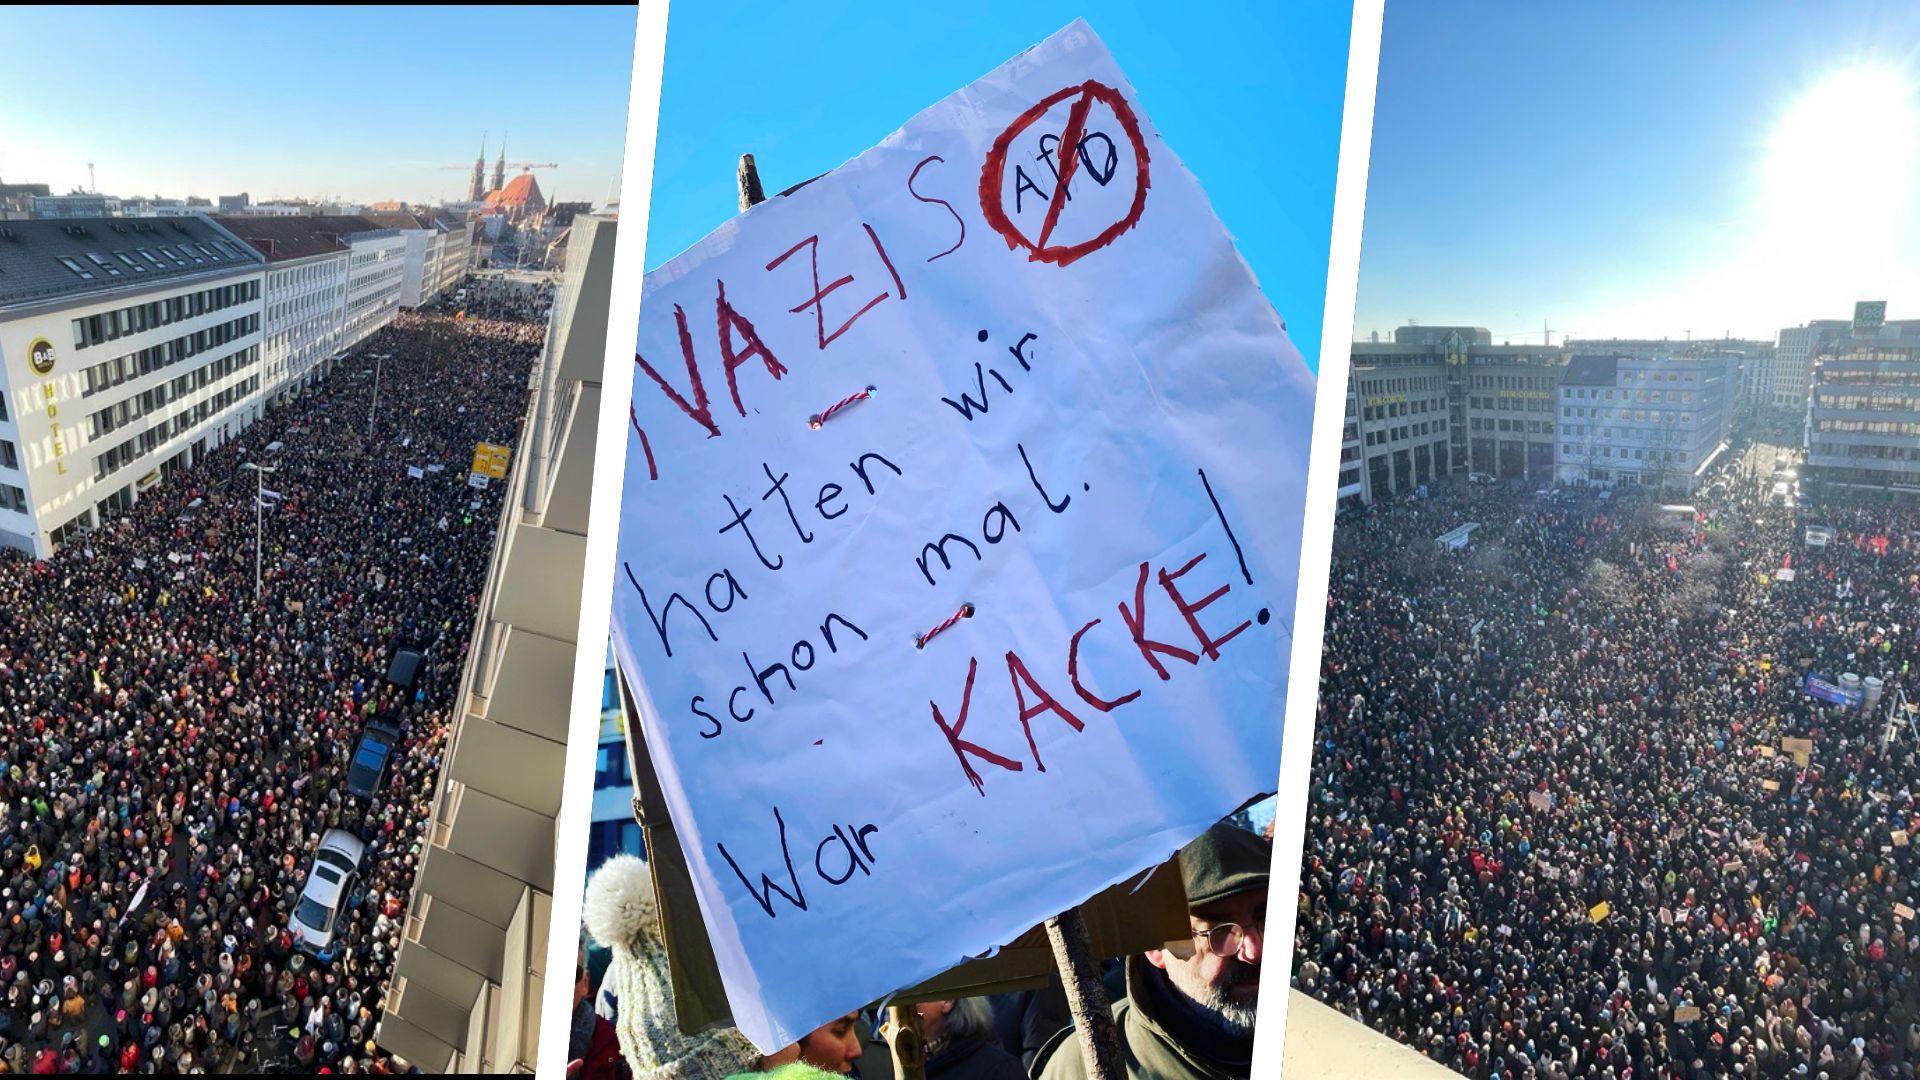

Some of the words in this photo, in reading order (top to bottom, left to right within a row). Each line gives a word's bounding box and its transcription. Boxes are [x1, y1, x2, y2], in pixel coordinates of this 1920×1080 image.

[1015, 130, 1119, 214] AfD
[33, 348, 56, 365] B&B
[630, 156, 966, 480] NAZIS
[43, 383, 67, 475] HOTEL
[624, 454, 902, 658] hatten
[942, 328, 1039, 421] wir
[692, 614, 868, 740] schon
[916, 444, 1093, 586] mal.
[718, 807, 880, 919] War
